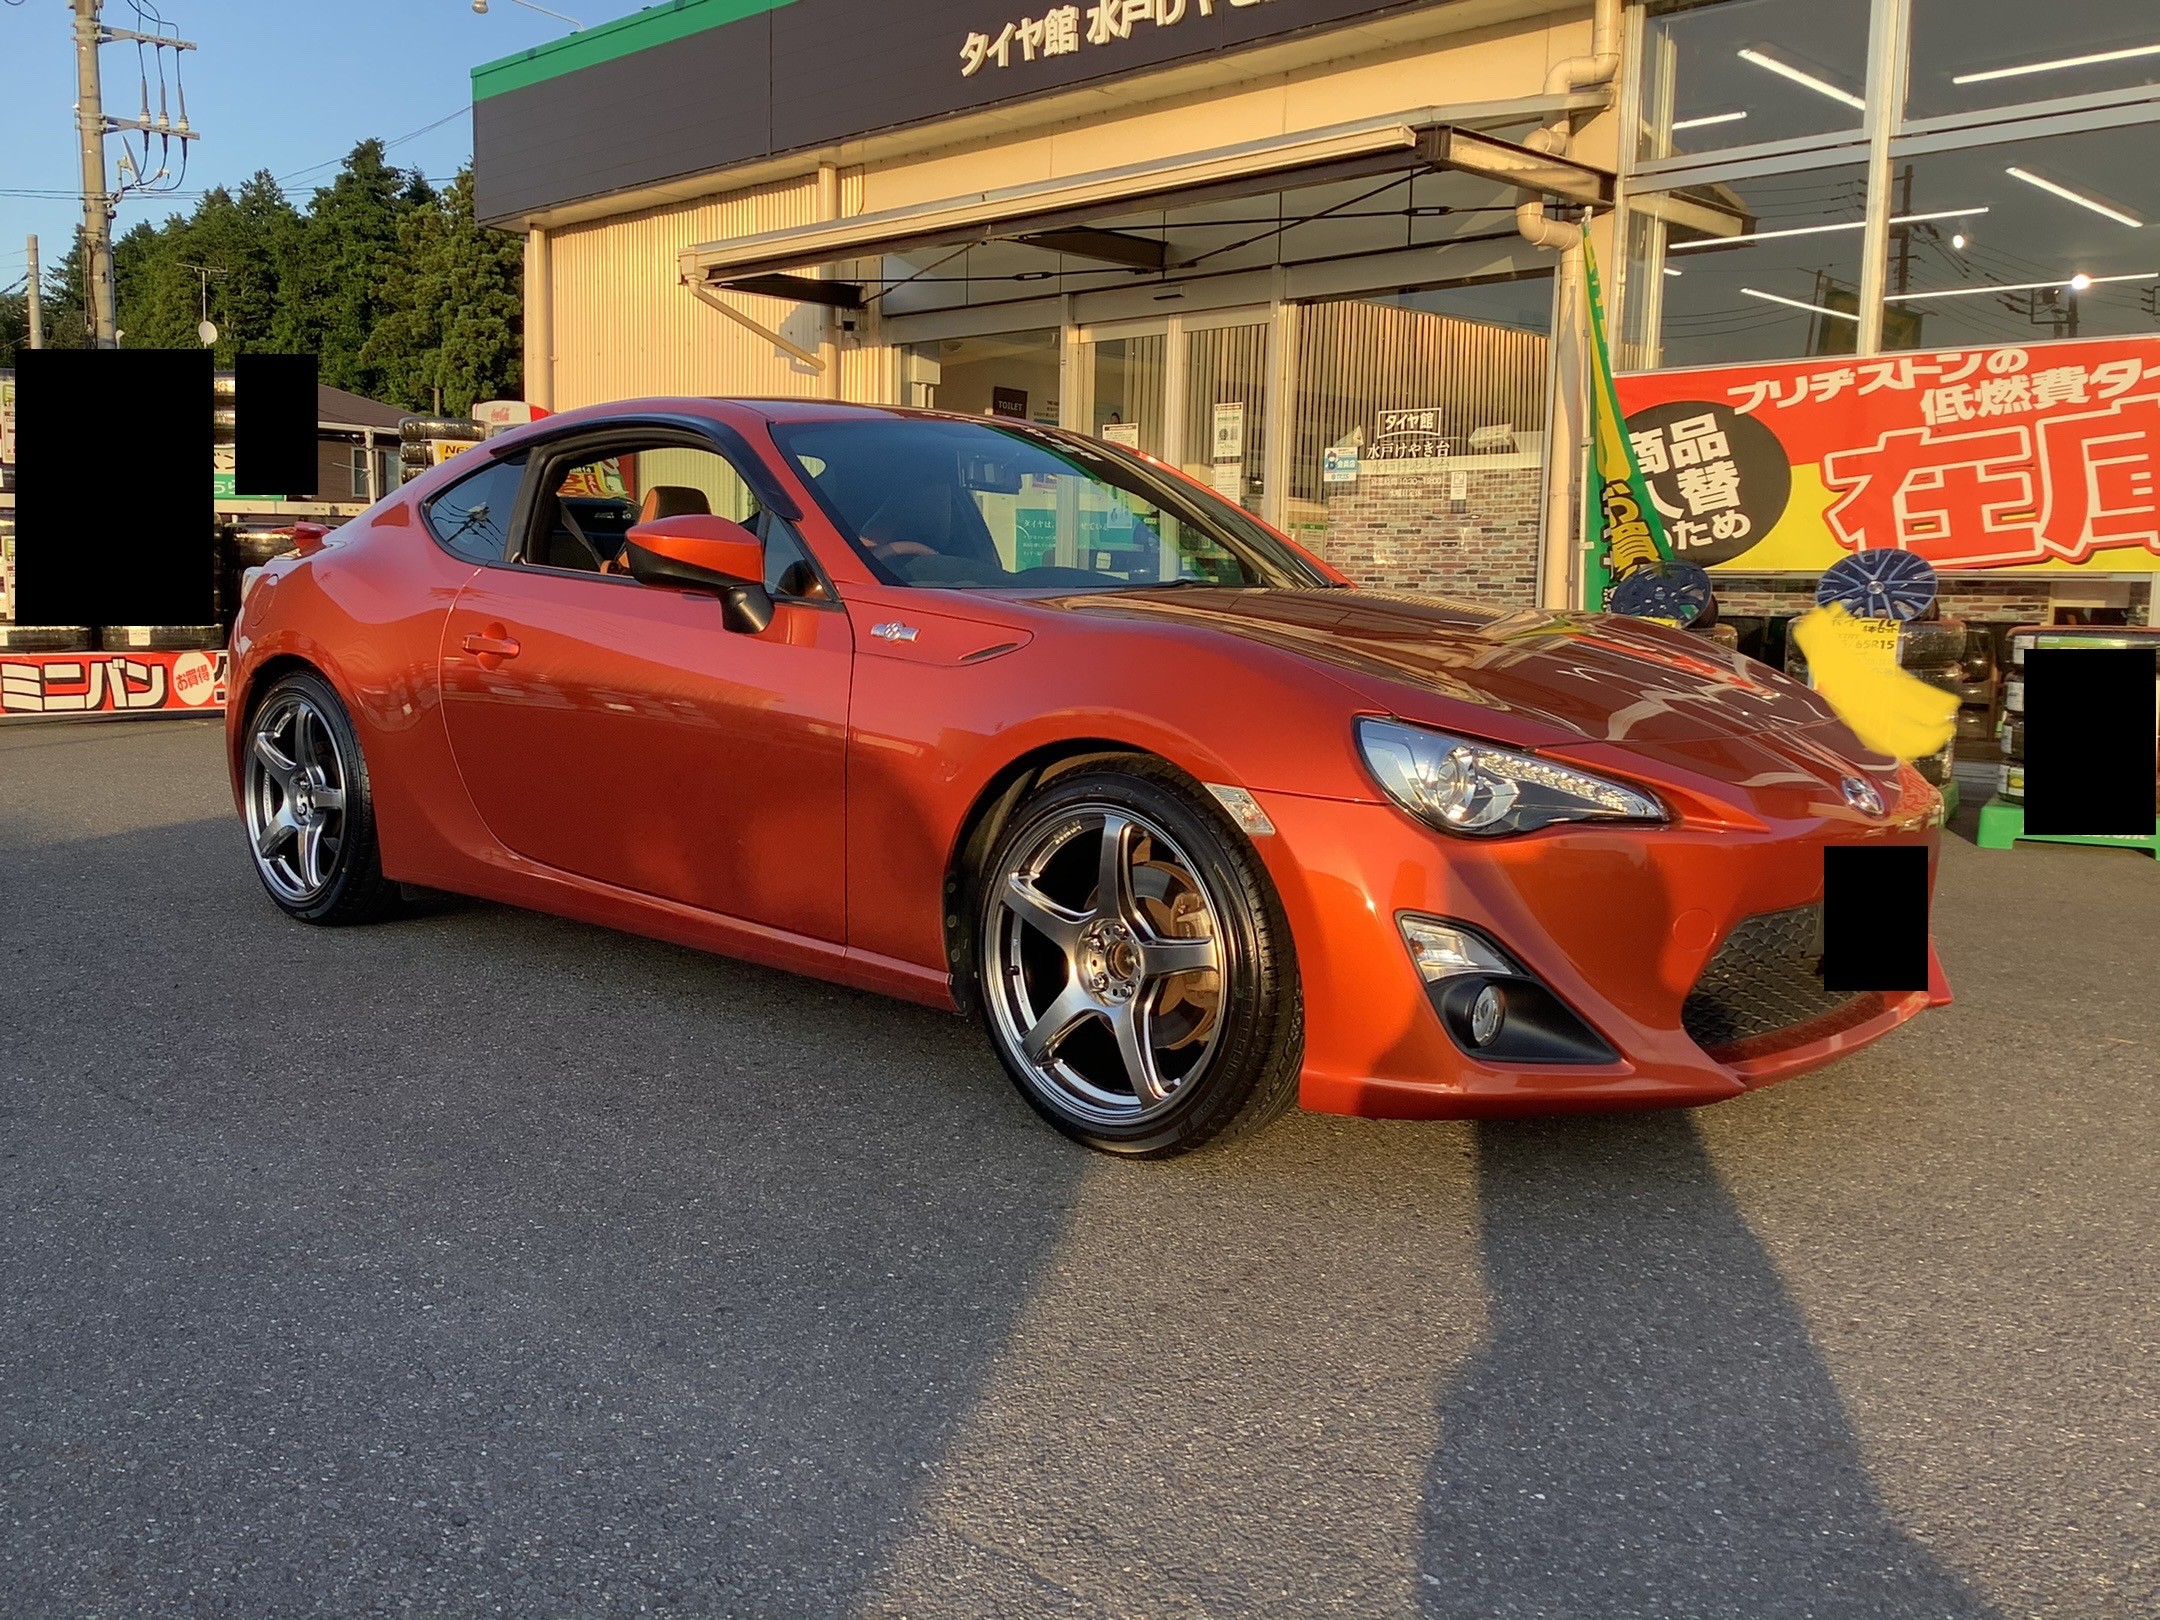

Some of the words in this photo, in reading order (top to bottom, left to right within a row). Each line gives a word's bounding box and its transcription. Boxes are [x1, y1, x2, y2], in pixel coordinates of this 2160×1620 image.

[959, 4, 1080, 77] タイヤ館
[1727, 348, 2029, 416] ブリヂストンの
[998, 400, 1023, 412] TOILET
[1385, 411, 1434, 431] タイヤ館
[445, 444, 468, 455] NE
[1366, 440, 1450, 459] 水戸けやき台
[1664, 509, 1751, 550] ため
[1, 657, 168, 712] ミニバン
[175, 664, 210, 691] お買得
